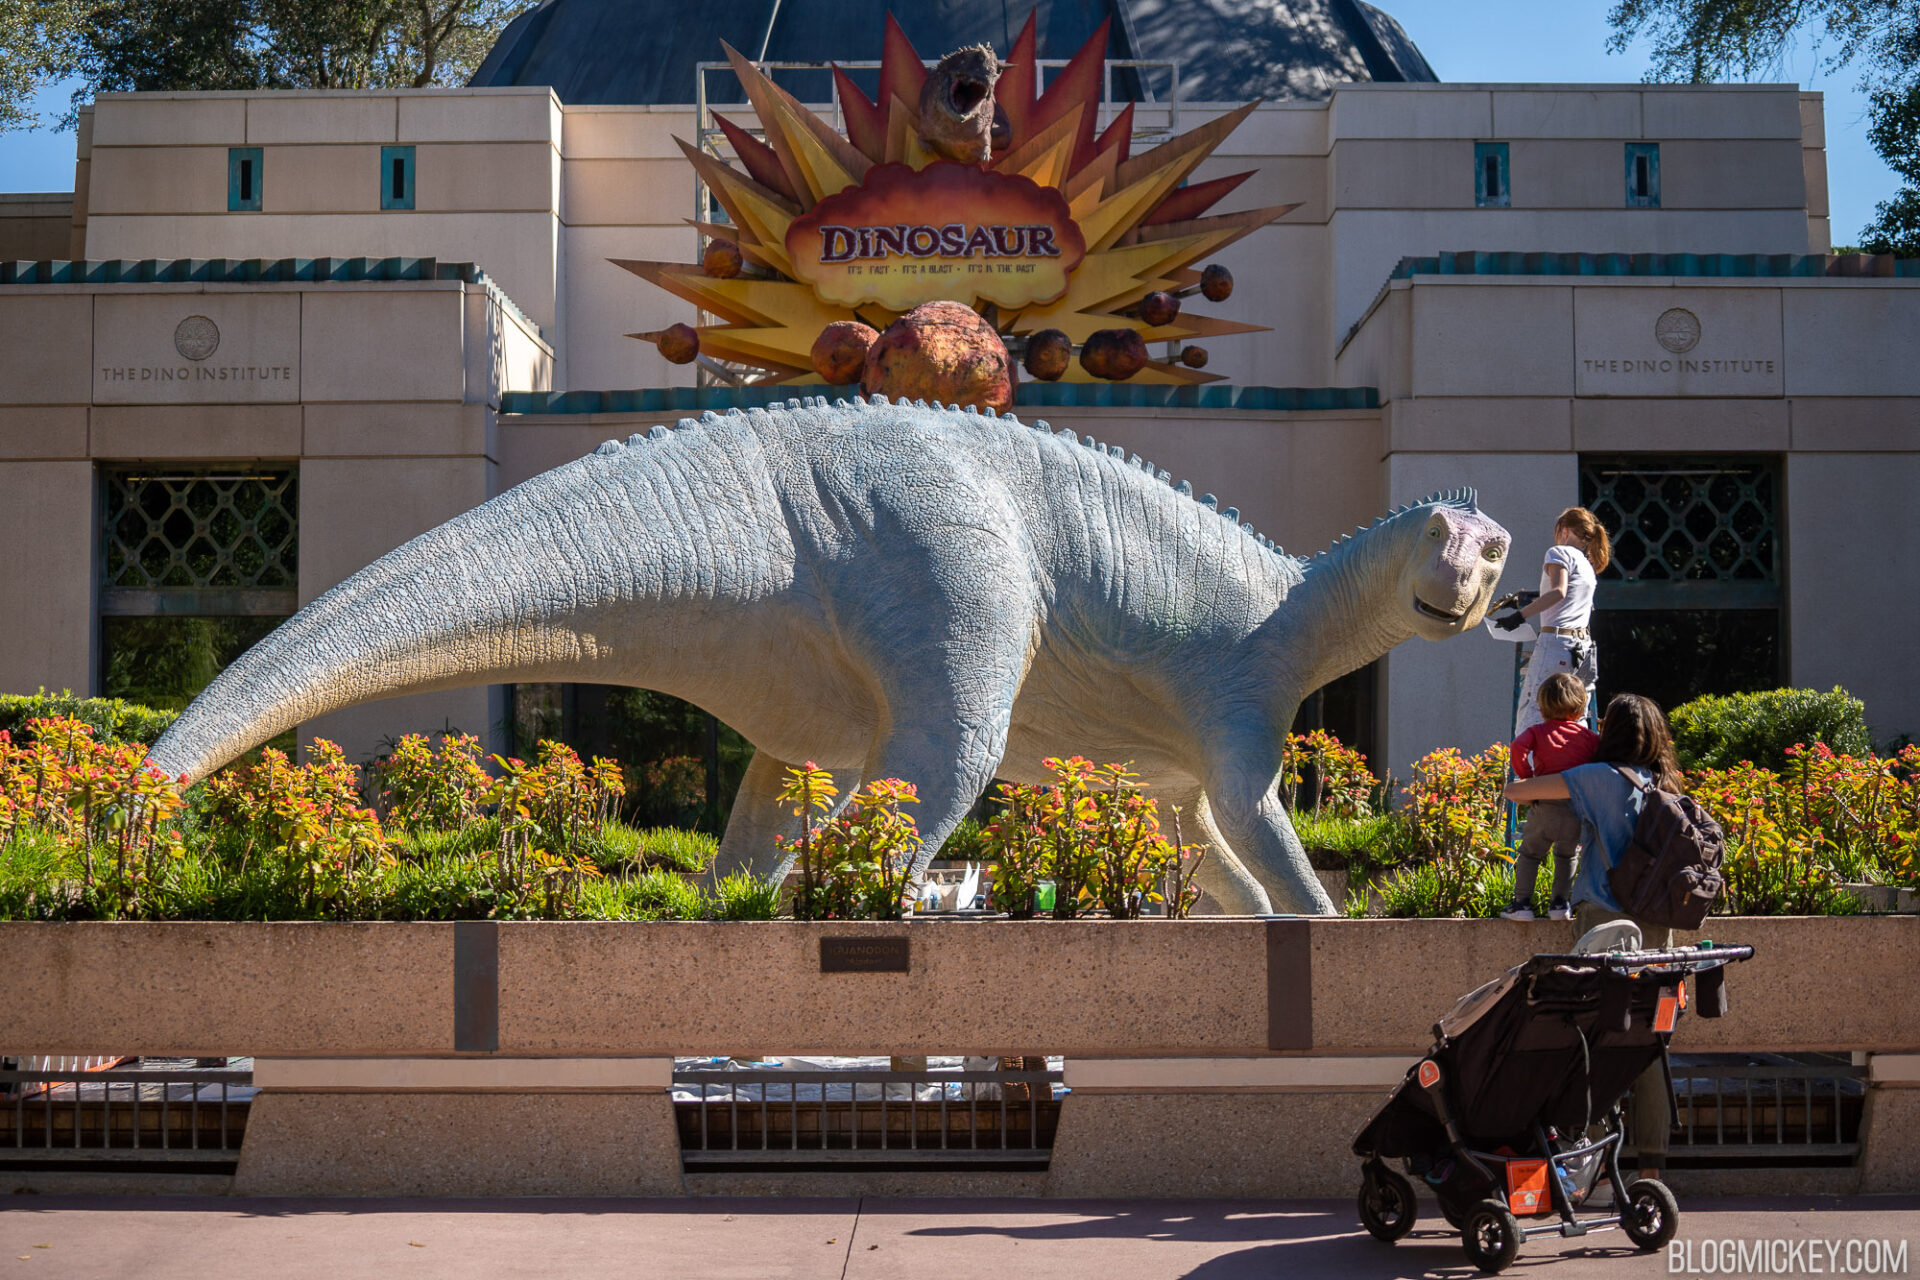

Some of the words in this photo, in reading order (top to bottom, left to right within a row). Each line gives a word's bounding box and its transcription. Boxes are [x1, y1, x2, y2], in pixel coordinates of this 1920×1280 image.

[820, 223, 1063, 264] DINOSAUR
[996, 264, 1012, 273] THE
[1016, 264, 1036, 273] PAST
[1583, 360, 1617, 373] THE
[1623, 360, 1673, 373] DINO
[1678, 360, 1775, 373] INSTITUTE
[102, 368, 136, 381] THE
[141, 367, 190, 381] DINO
[196, 367, 291, 380] INSTITUTE
